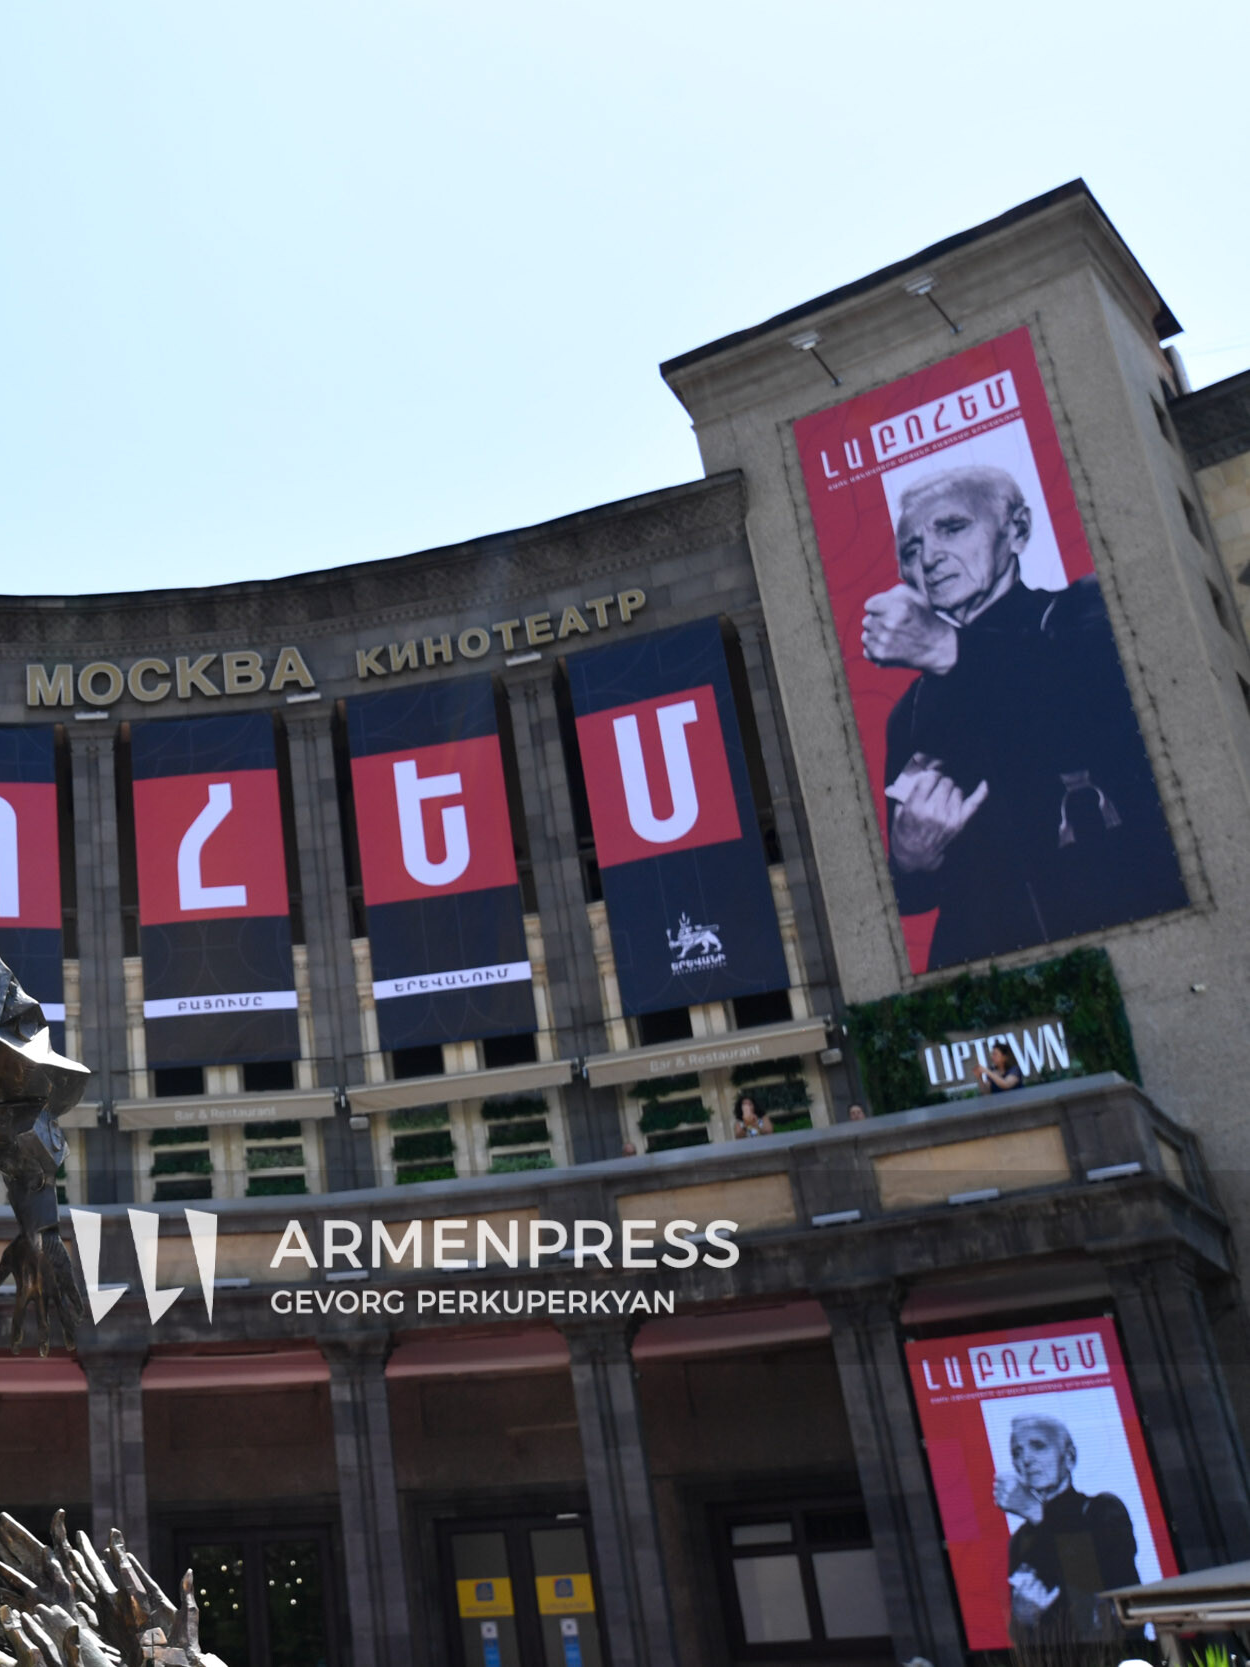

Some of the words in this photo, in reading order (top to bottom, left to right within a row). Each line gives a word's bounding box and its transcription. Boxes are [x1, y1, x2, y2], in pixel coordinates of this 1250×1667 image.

[821, 438, 864, 479] ԼԱ
[26, 646, 316, 707] МОСКВА
[355, 588, 647, 679] КИНОТЕАТР
[649, 1059, 671, 1073] Bar
[690, 1043, 761, 1066] Restaurant
